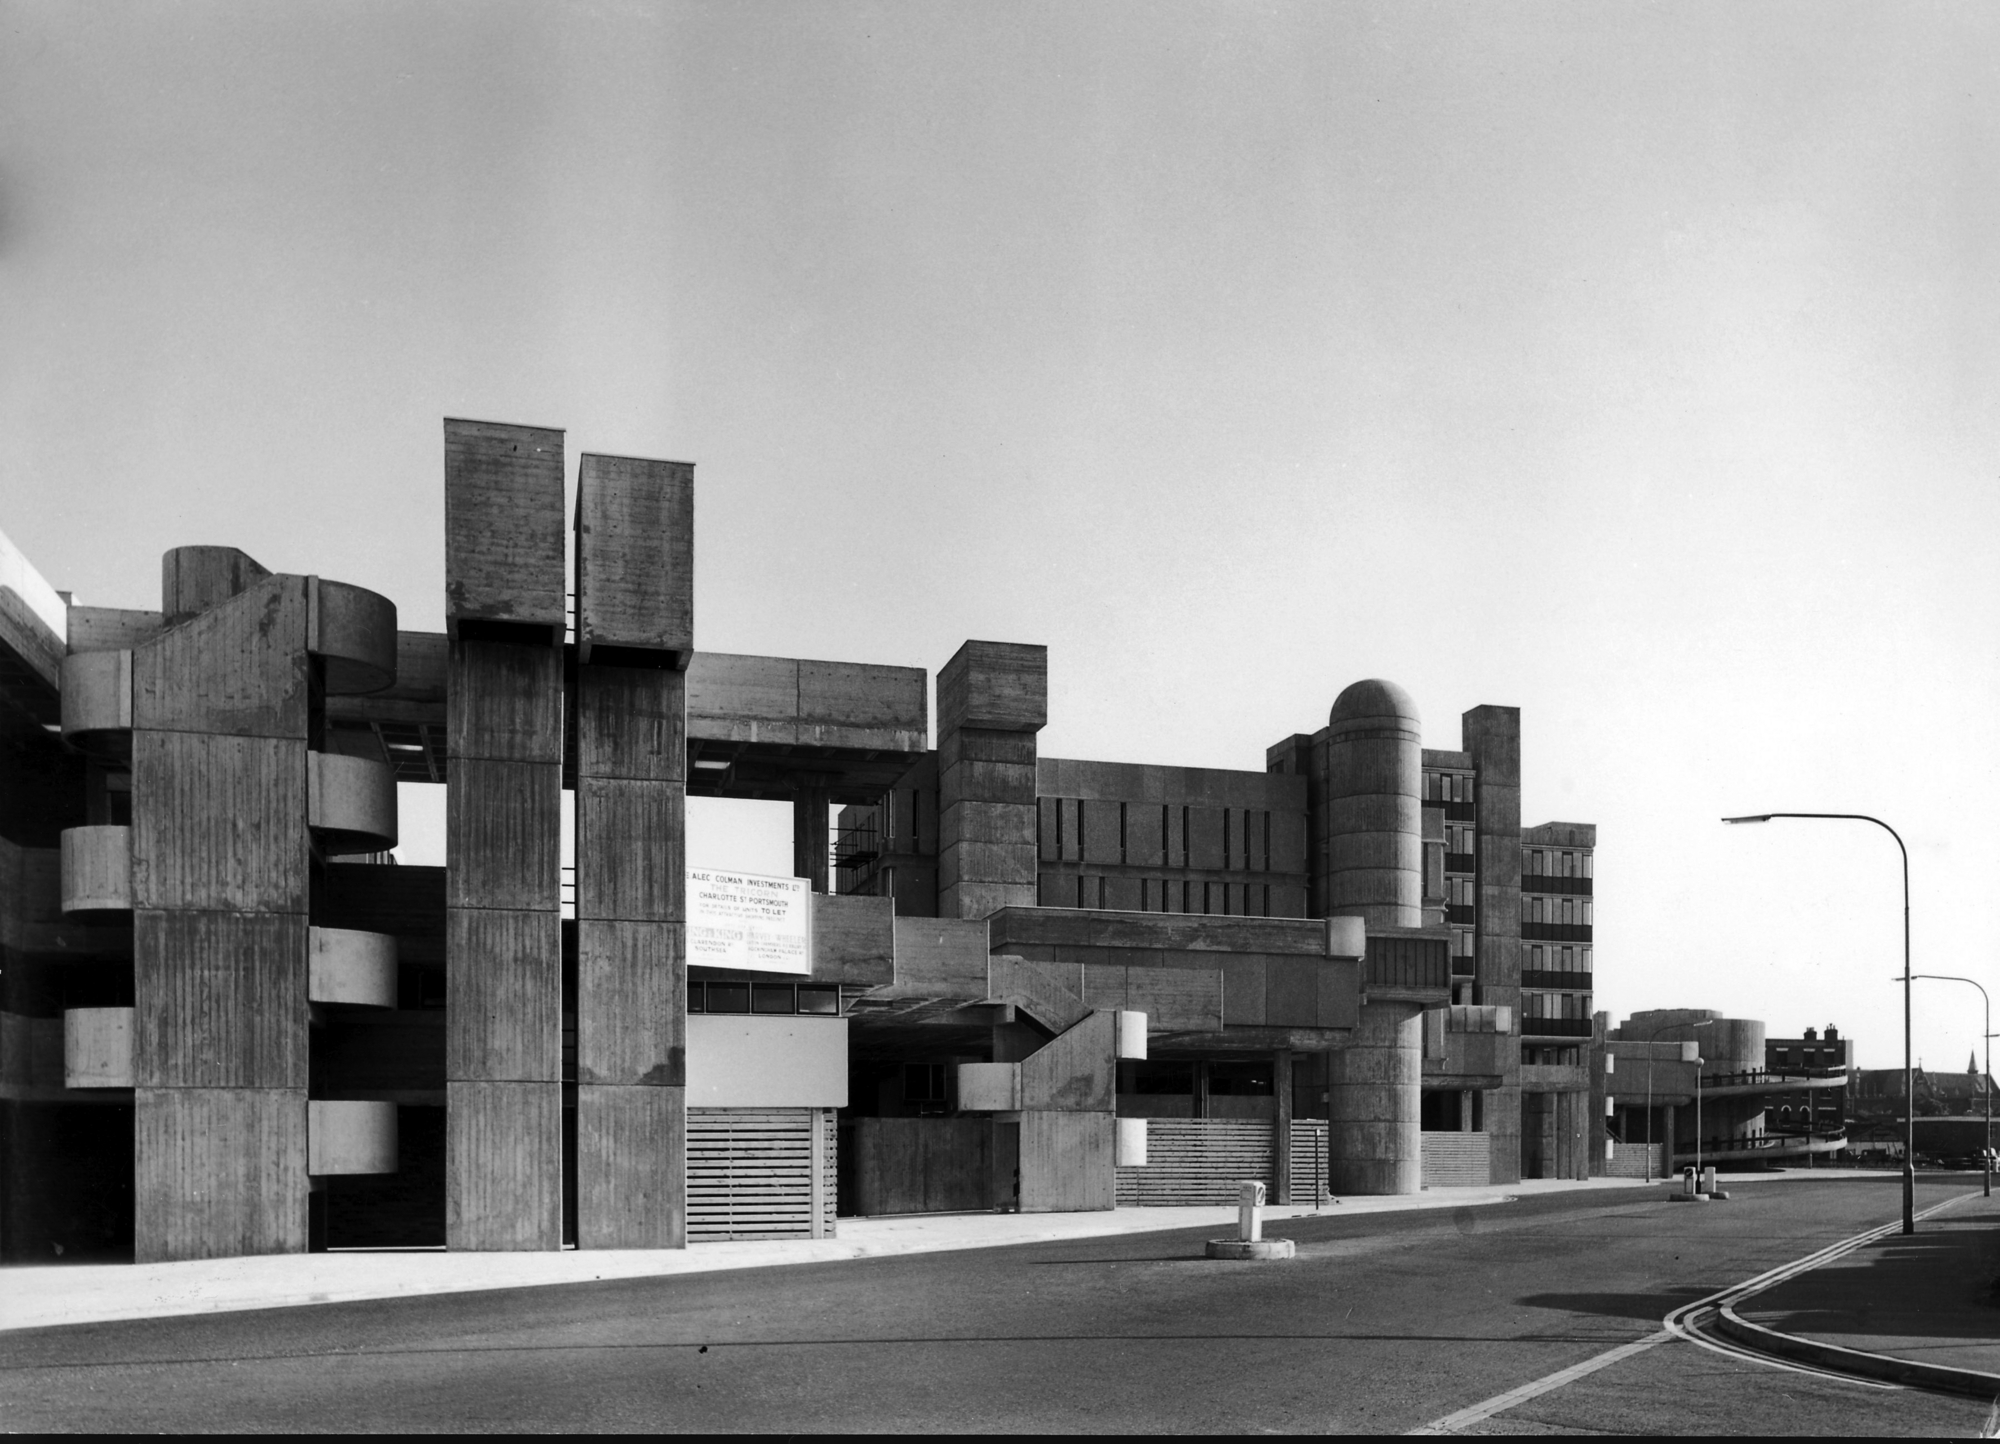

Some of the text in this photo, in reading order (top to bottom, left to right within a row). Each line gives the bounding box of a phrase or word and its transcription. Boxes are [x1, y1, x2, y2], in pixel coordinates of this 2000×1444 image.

[692, 873, 710, 882] ALEC
[715, 875, 743, 884] COLMAN
[747, 879, 789, 890] INVESTMENTS
[710, 884, 778, 898] THE TRICORN
[699, 892, 737, 902] CHARLOTTE
[749, 897, 788, 908] PORTSMOUTH
[714, 928, 743, 940] KING
[690, 938, 726, 946] CLARENDON
